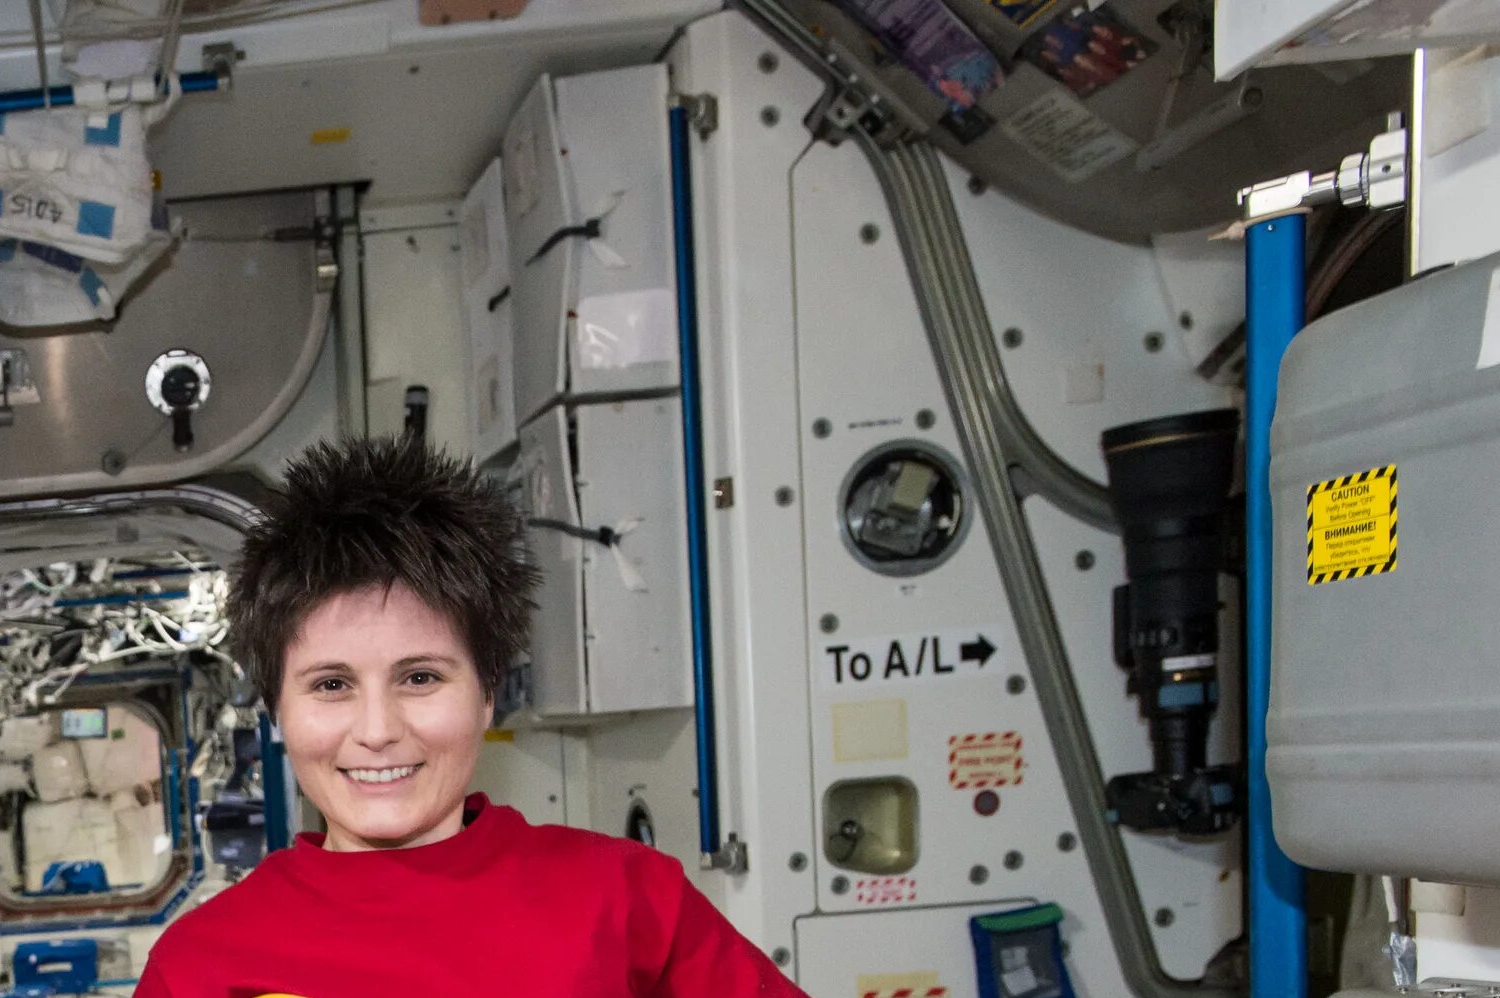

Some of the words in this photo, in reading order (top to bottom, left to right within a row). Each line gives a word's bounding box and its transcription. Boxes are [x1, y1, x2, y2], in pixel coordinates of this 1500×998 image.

[1331, 484, 1370, 503] CAUTION
[1324, 520, 1377, 541] ВНИМАНИЕ!
[825, 645, 871, 684] To
[884, 636, 955, 680] A/L
